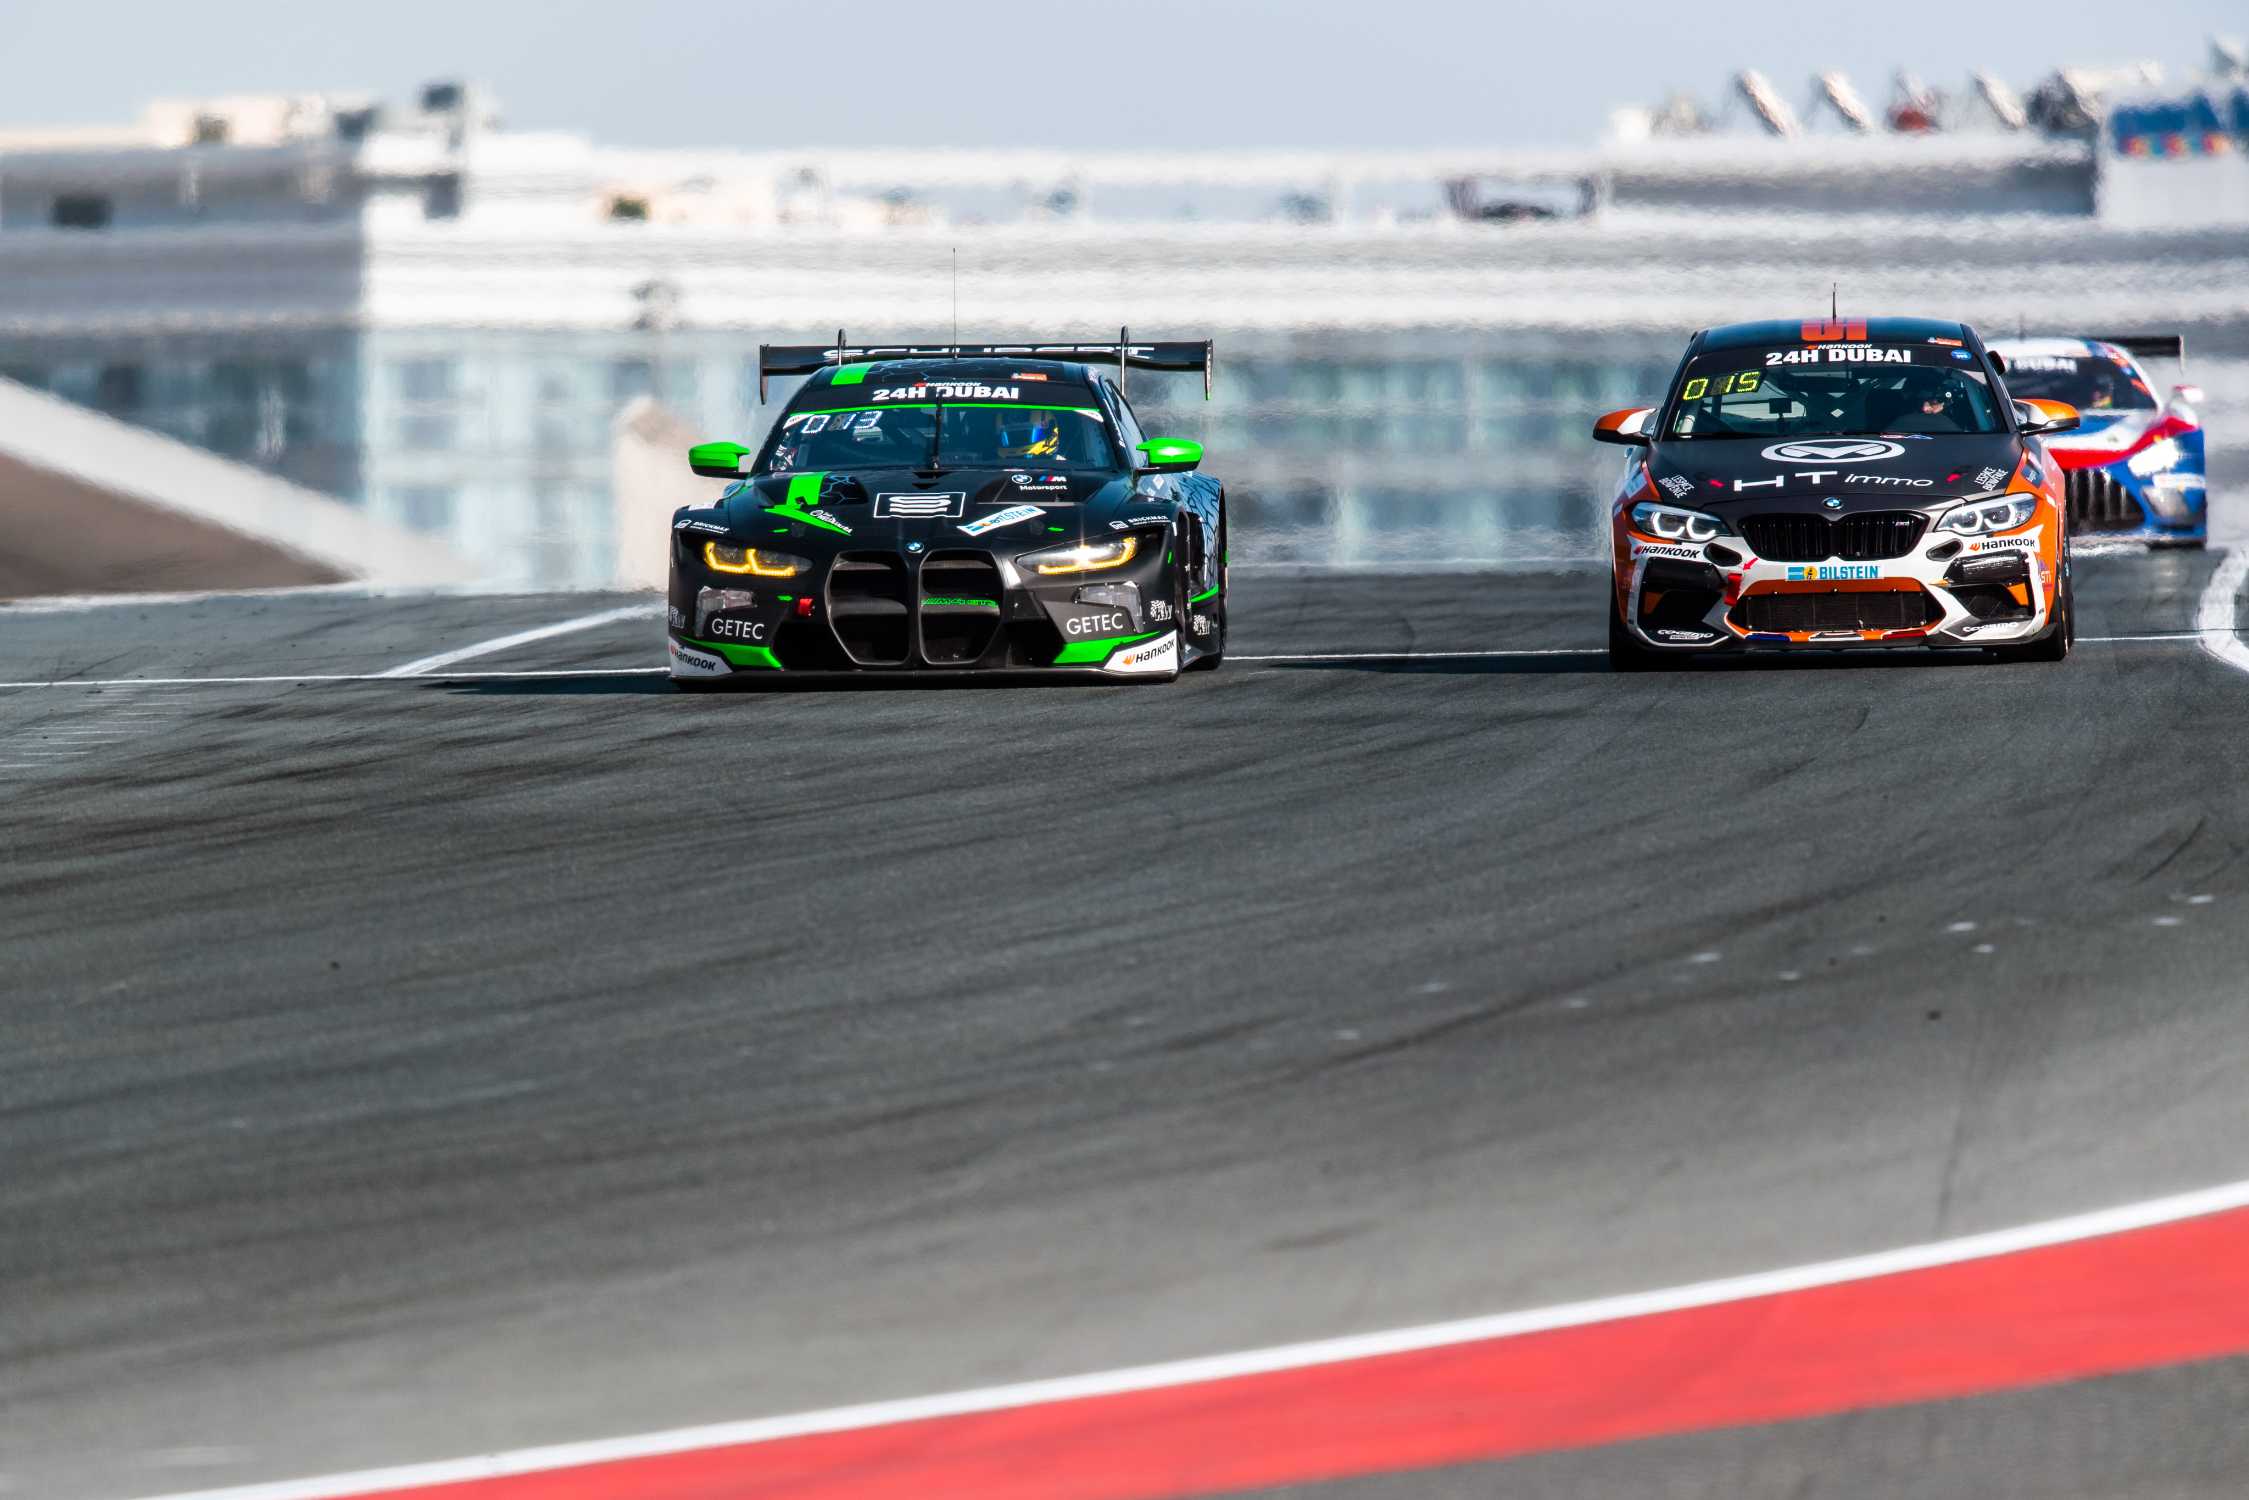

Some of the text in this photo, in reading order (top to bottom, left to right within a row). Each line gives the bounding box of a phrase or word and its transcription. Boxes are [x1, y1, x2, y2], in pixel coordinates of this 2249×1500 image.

[1766, 350, 1911, 366] 24H DUBAI
[872, 386, 1019, 402] 24H DUBAI
[989, 506, 1037, 525] BILSTEIN
[1819, 565, 1880, 580] BILSTEIN
[711, 618, 765, 640] GETEC
[1066, 612, 1124, 635] GETEC
